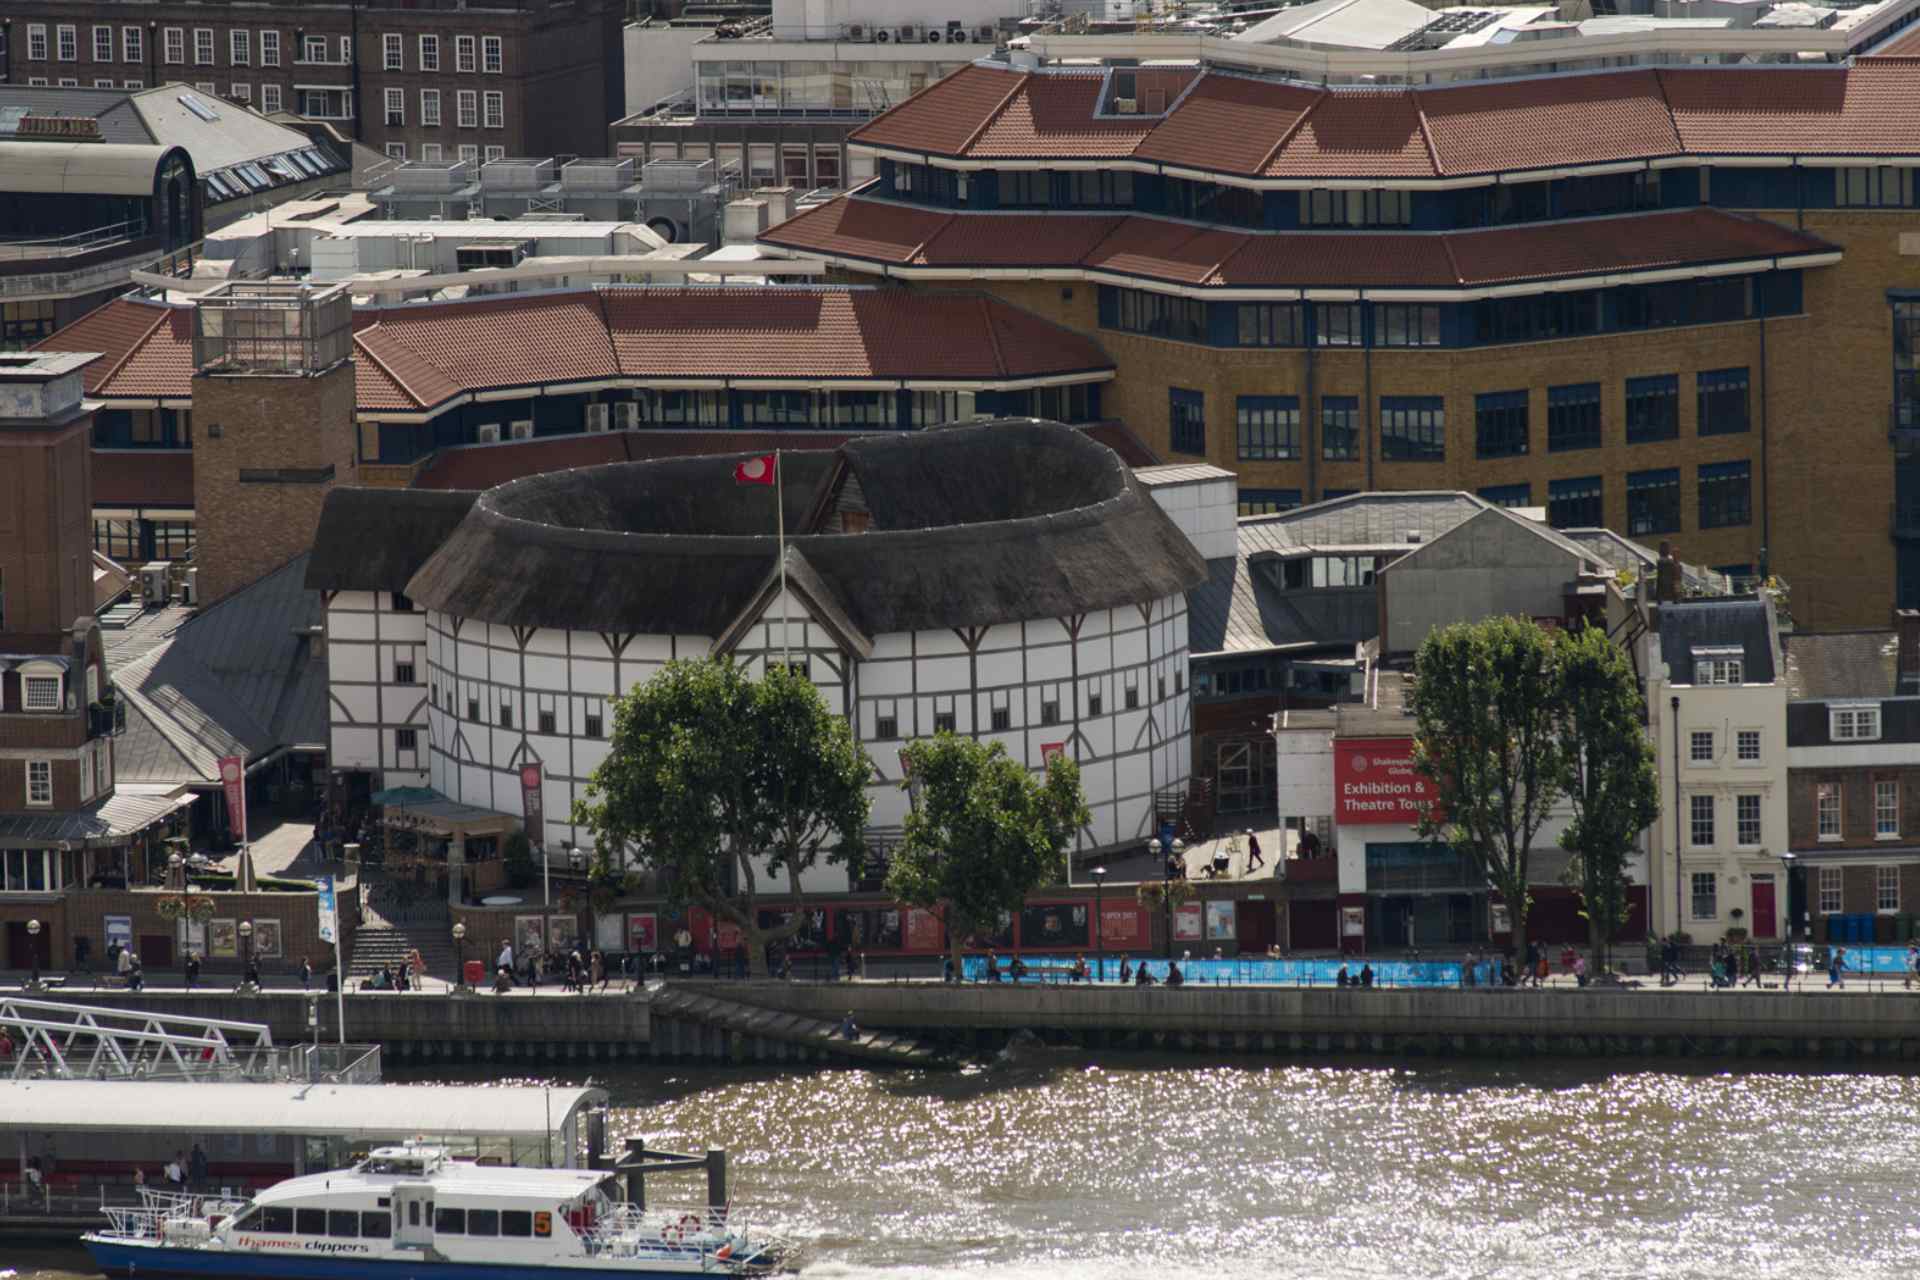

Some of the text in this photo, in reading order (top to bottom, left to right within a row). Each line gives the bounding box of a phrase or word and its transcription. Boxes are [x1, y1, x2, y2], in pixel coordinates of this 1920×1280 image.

[1343, 781, 1425, 795] Exhibition &
[1343, 799, 1395, 811] Theatre
[534, 1212, 551, 1233] 5
[238, 1236, 369, 1253] thames clippers
